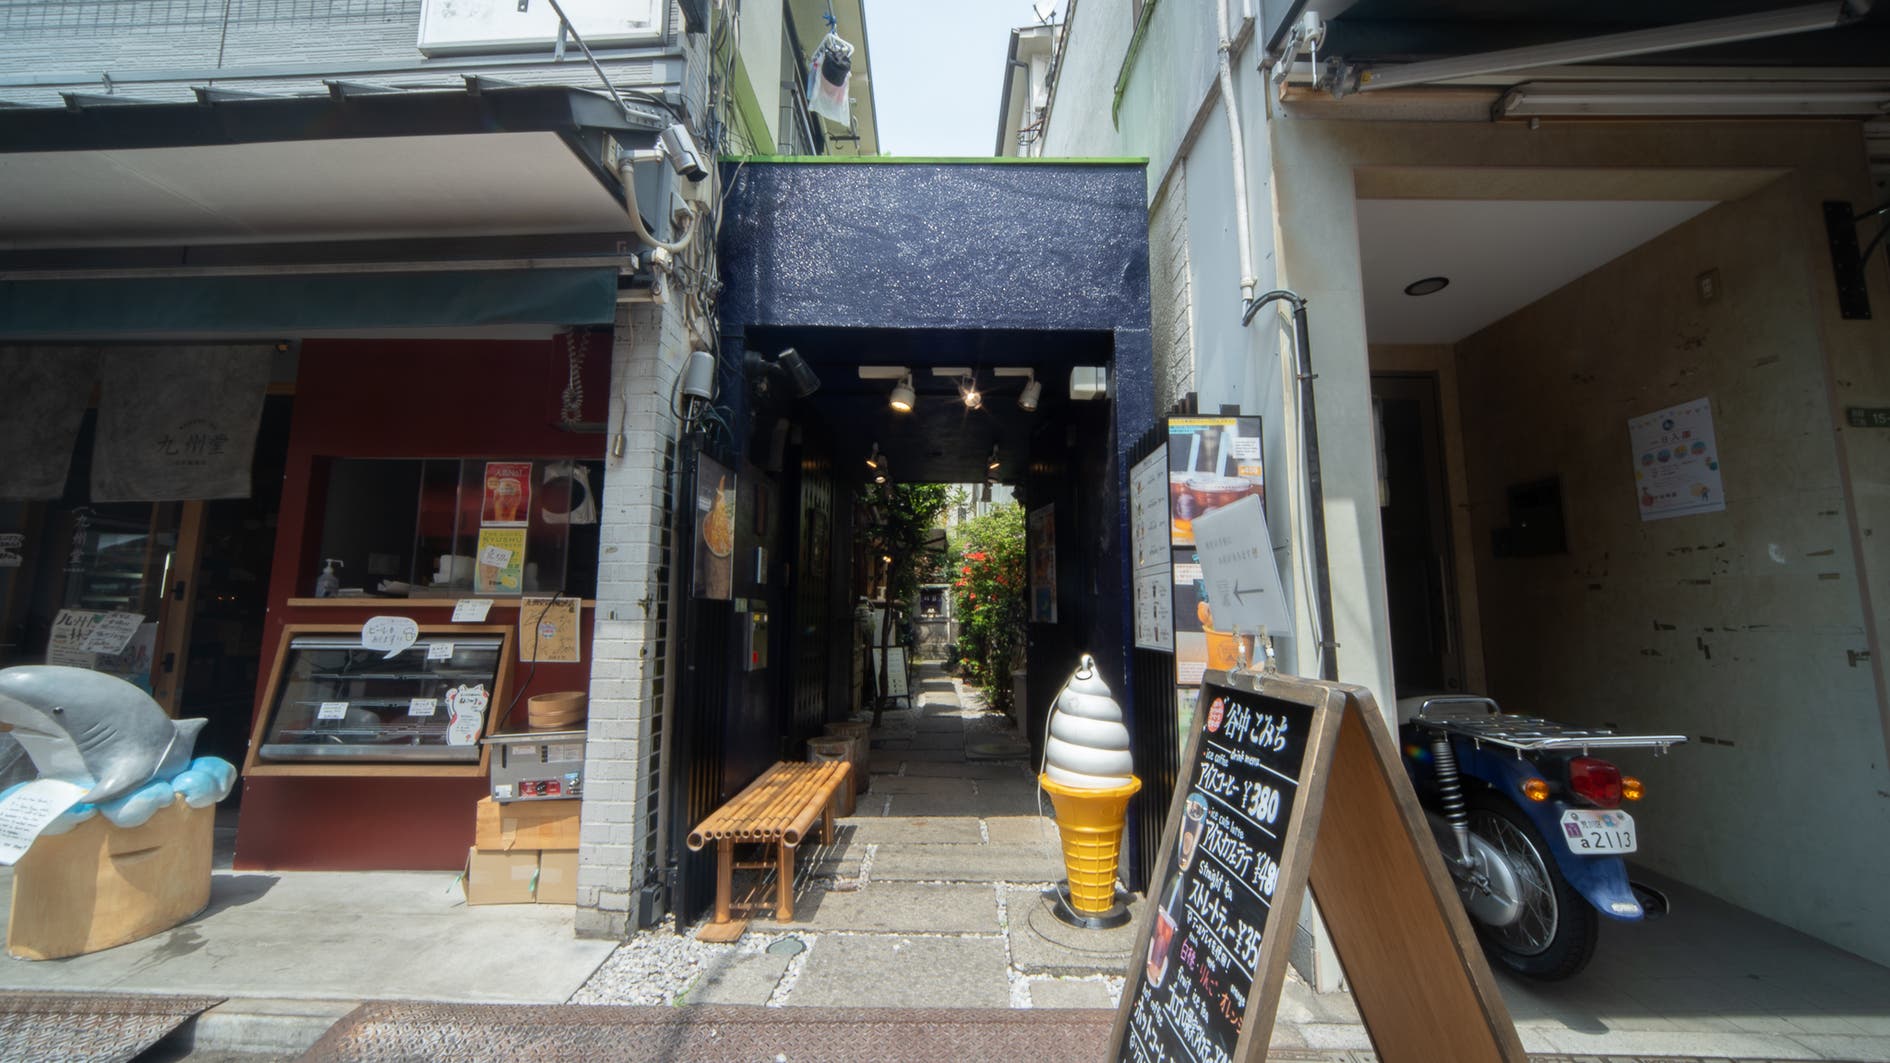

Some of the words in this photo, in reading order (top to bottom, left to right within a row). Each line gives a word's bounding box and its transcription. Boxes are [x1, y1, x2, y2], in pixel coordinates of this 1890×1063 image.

[157, 432, 229, 456] 九州堂
[1198, 762, 1240, 796] アイスコーヒー
[1241, 780, 1280, 824] ¥380
[1203, 818, 1254, 877] アイスカフェラテ
[1252, 851, 1280, 896] ¥48
[1188, 878, 1236, 940] ストレートティー
[1234, 919, 1262, 971] ¥35
